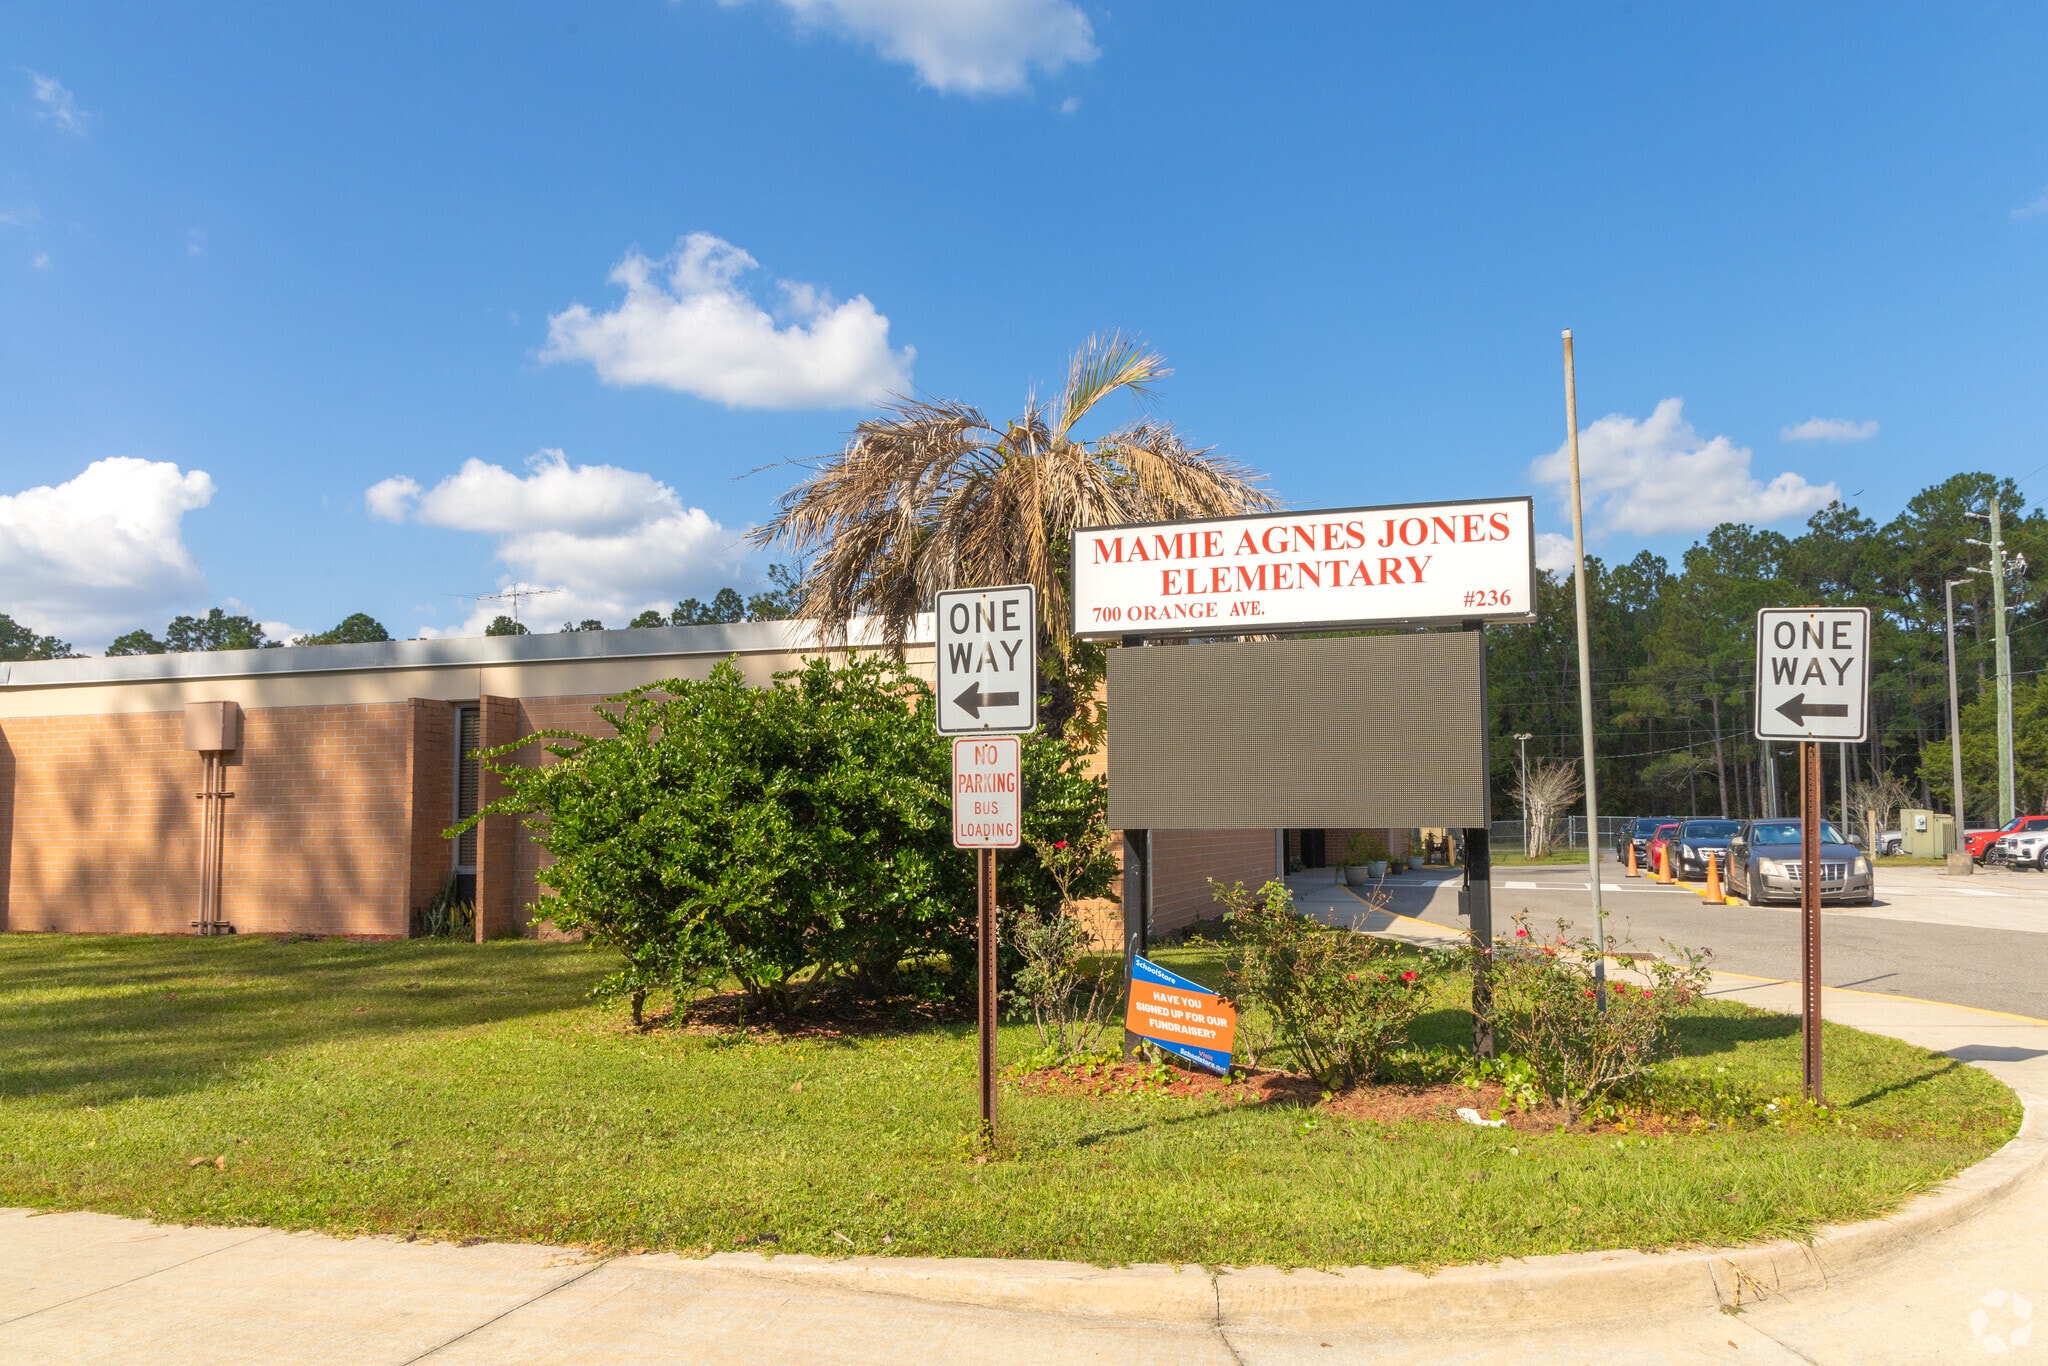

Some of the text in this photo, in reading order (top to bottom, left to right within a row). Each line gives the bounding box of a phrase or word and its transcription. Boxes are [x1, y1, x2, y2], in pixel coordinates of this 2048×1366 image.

[1093, 511, 1511, 564] MAMIE AGNES JONES
[1160, 554, 1433, 597] ELEMENTARY
[1463, 588, 1512, 609] #236
[949, 599, 1021, 635] ONE
[1092, 600, 1266, 624] 700 ORANGE AVE.
[1773, 621, 1853, 650] ONE
[948, 638, 1023, 674] WAY
[1771, 657, 1855, 686] WAY
[974, 745, 998, 766] NO
[958, 772, 1015, 794] PARKING
[974, 801, 999, 815] BUS
[960, 822, 1013, 837] LOADING
[1135, 959, 1176, 985] SchoolStore
[1152, 991, 1202, 1009] HAVE YOU
[1135, 1001, 1228, 1028] SIGNED UP FOR OUR
[1149, 1018, 1217, 1040] FUNDRAISER?
